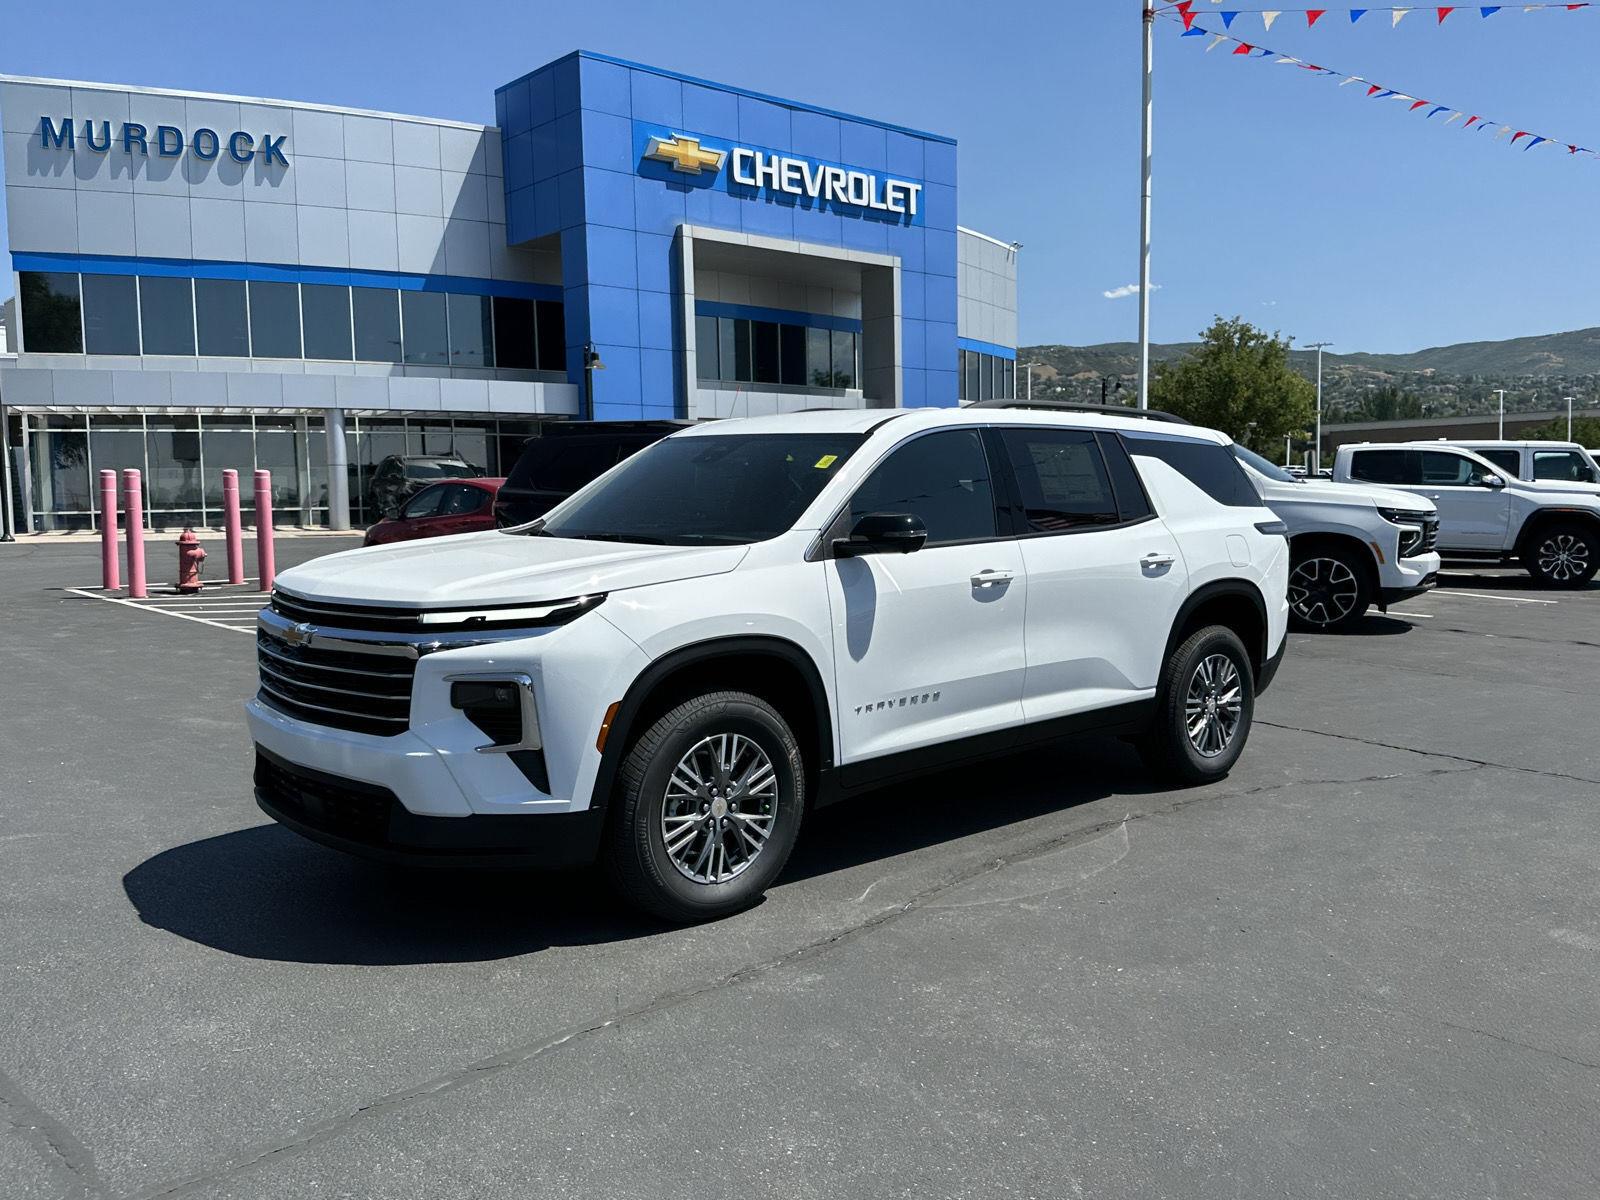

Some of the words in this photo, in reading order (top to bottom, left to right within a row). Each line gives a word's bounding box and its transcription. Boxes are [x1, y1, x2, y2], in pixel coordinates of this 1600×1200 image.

[40, 116, 290, 167] MURDOCK
[733, 147, 922, 215] CHEVROLET
[854, 691, 941, 715] TRAVERSE
